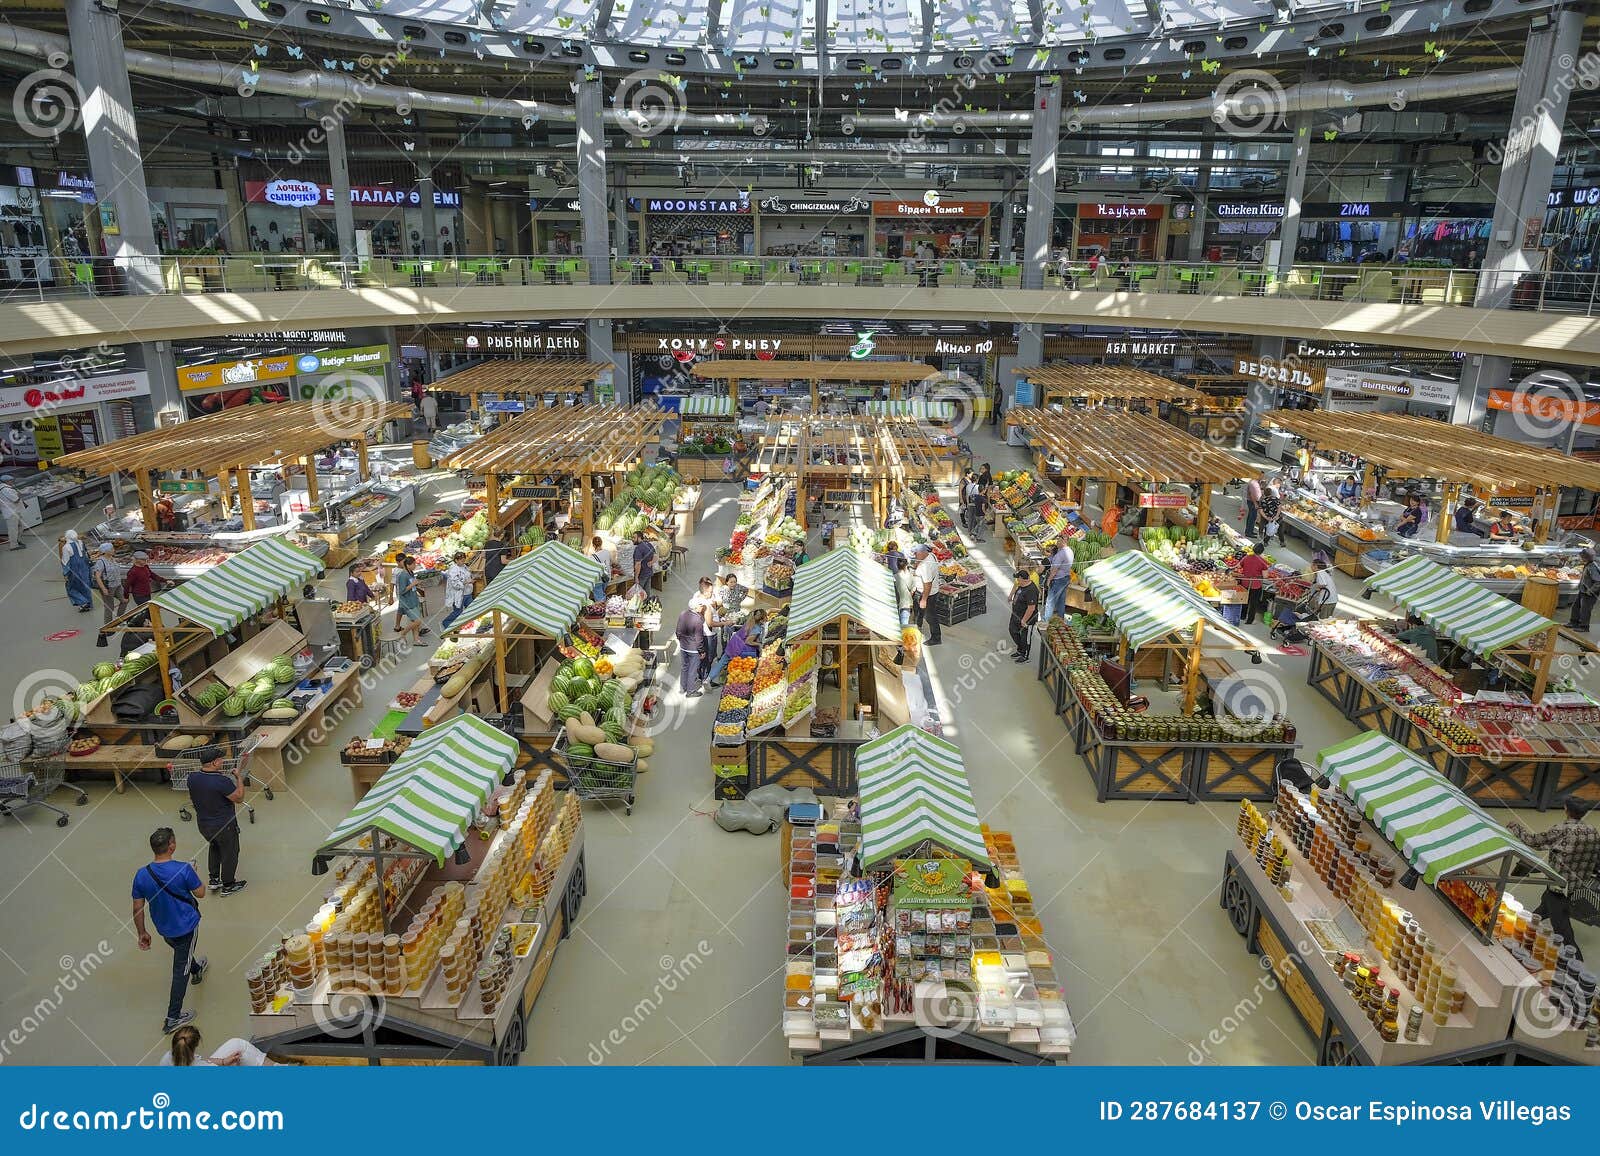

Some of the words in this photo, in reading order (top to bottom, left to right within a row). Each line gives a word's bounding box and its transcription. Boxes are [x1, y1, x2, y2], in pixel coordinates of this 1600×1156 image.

[650, 200, 737, 211] MOONSTAR
[1218, 204, 1258, 215] Chicken
[1259, 204, 1284, 217] King
[487, 334, 542, 348] РЫБНЫЙ
[546, 337, 580, 349] ДЕНЬ
[658, 338, 708, 349] ХОЧУ
[732, 339, 781, 350] РЫБУ
[975, 339, 993, 353] ПФ
[1106, 343, 1127, 354] A&A
[1132, 343, 1176, 355] MARKET
[354, 352, 381, 363] Natural
[1239, 361, 1313, 386] ВЕРСАЛЬ
[1362, 381, 1410, 394] ВЫПЕЧКИН
